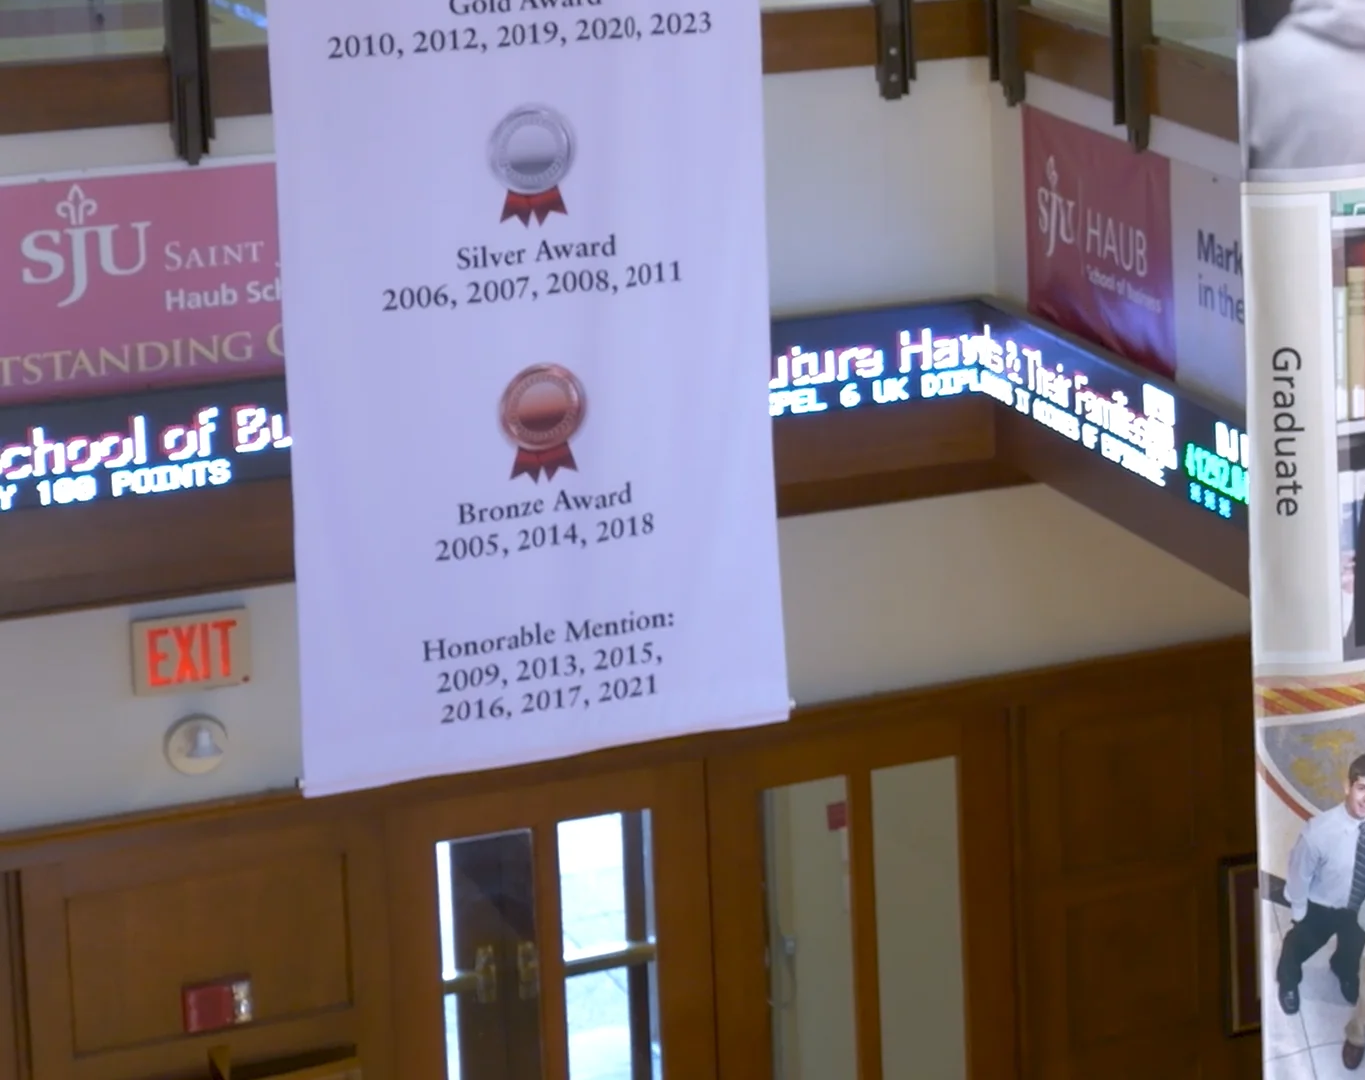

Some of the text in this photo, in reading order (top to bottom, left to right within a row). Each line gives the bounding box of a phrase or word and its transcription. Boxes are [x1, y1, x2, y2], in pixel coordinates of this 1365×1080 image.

[327, 11, 712, 60] 2010, 2012, 2019, 2020, 2023
[1037, 186, 1075, 258] SJU
[1085, 207, 1148, 279] HAUB
[20, 222, 151, 308] SJU
[457, 235, 616, 270] Silver Award
[165, 283, 237, 311] Haub
[383, 261, 682, 312] 2006, 2007, 2008, 2011
[1198, 273, 1244, 325] in the
[839, 383, 862, 408] 6
[872, 376, 910, 404] UK
[163, 406, 219, 462] of
[1272, 347, 1305, 517] Graduate
[111, 459, 232, 499] POINTS
[459, 482, 632, 524] Bronze Award
[436, 513, 654, 561] 2005, 2014, 2018
[147, 617, 237, 688] EXIT
[423, 610, 674, 662] Honorable Mention:
[438, 643, 663, 694] 2009, 2013, 2015,
[441, 674, 658, 724] 2016, 2017, 2021
